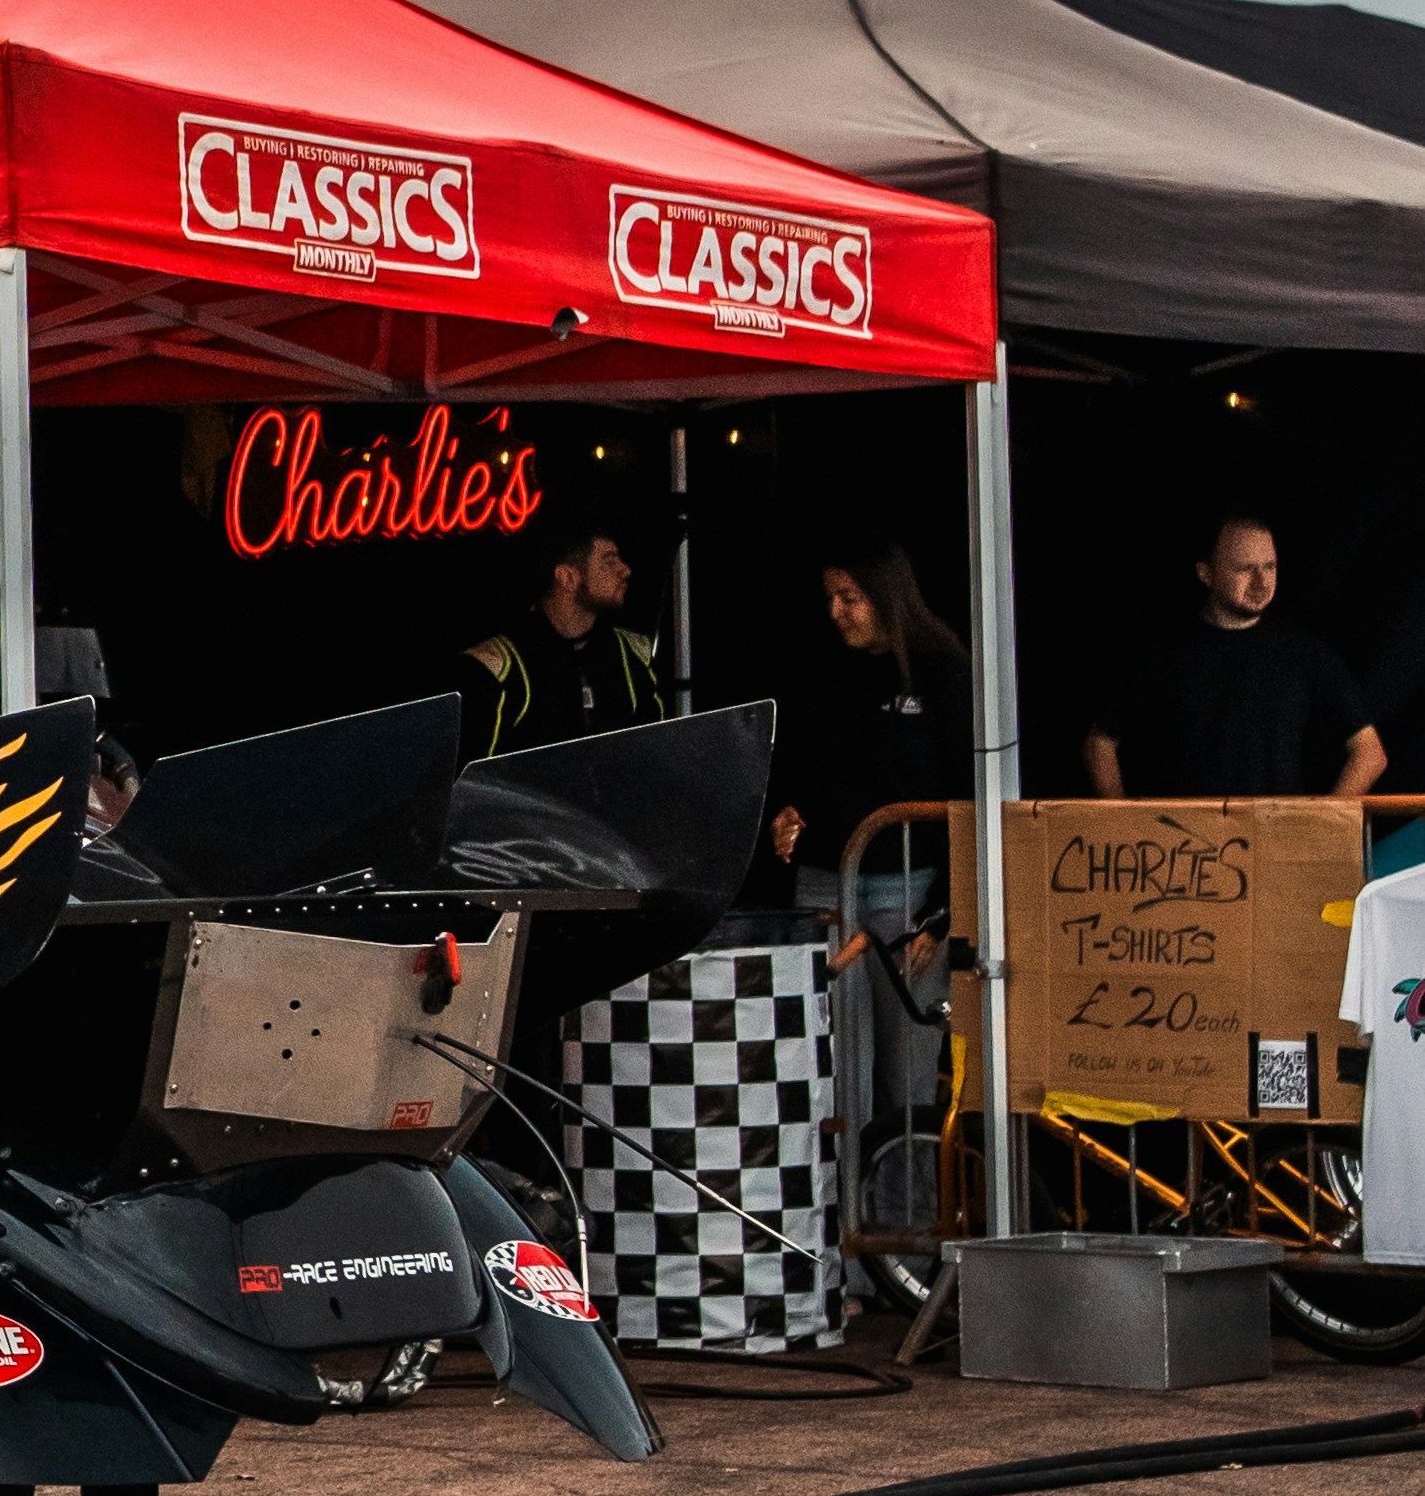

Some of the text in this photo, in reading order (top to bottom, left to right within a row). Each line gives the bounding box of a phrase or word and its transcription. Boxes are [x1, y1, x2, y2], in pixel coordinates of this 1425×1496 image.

[244, 136, 424, 176] BUYING RESTORING REPAIRING
[188, 132, 469, 261] CLASSICS
[667, 205, 828, 244] BUYING RESTORING REPAIRING
[299, 245, 372, 275] MONTHLY
[616, 202, 865, 325] CLASSICS
[718, 305, 780, 330] MONTHLY
[226, 405, 542, 555] Charlie's
[1061, 913, 1216, 966] T-SHIRTS
[343, 1252, 453, 1281] ENGINEERING
[518, 1265, 563, 1292] RED
